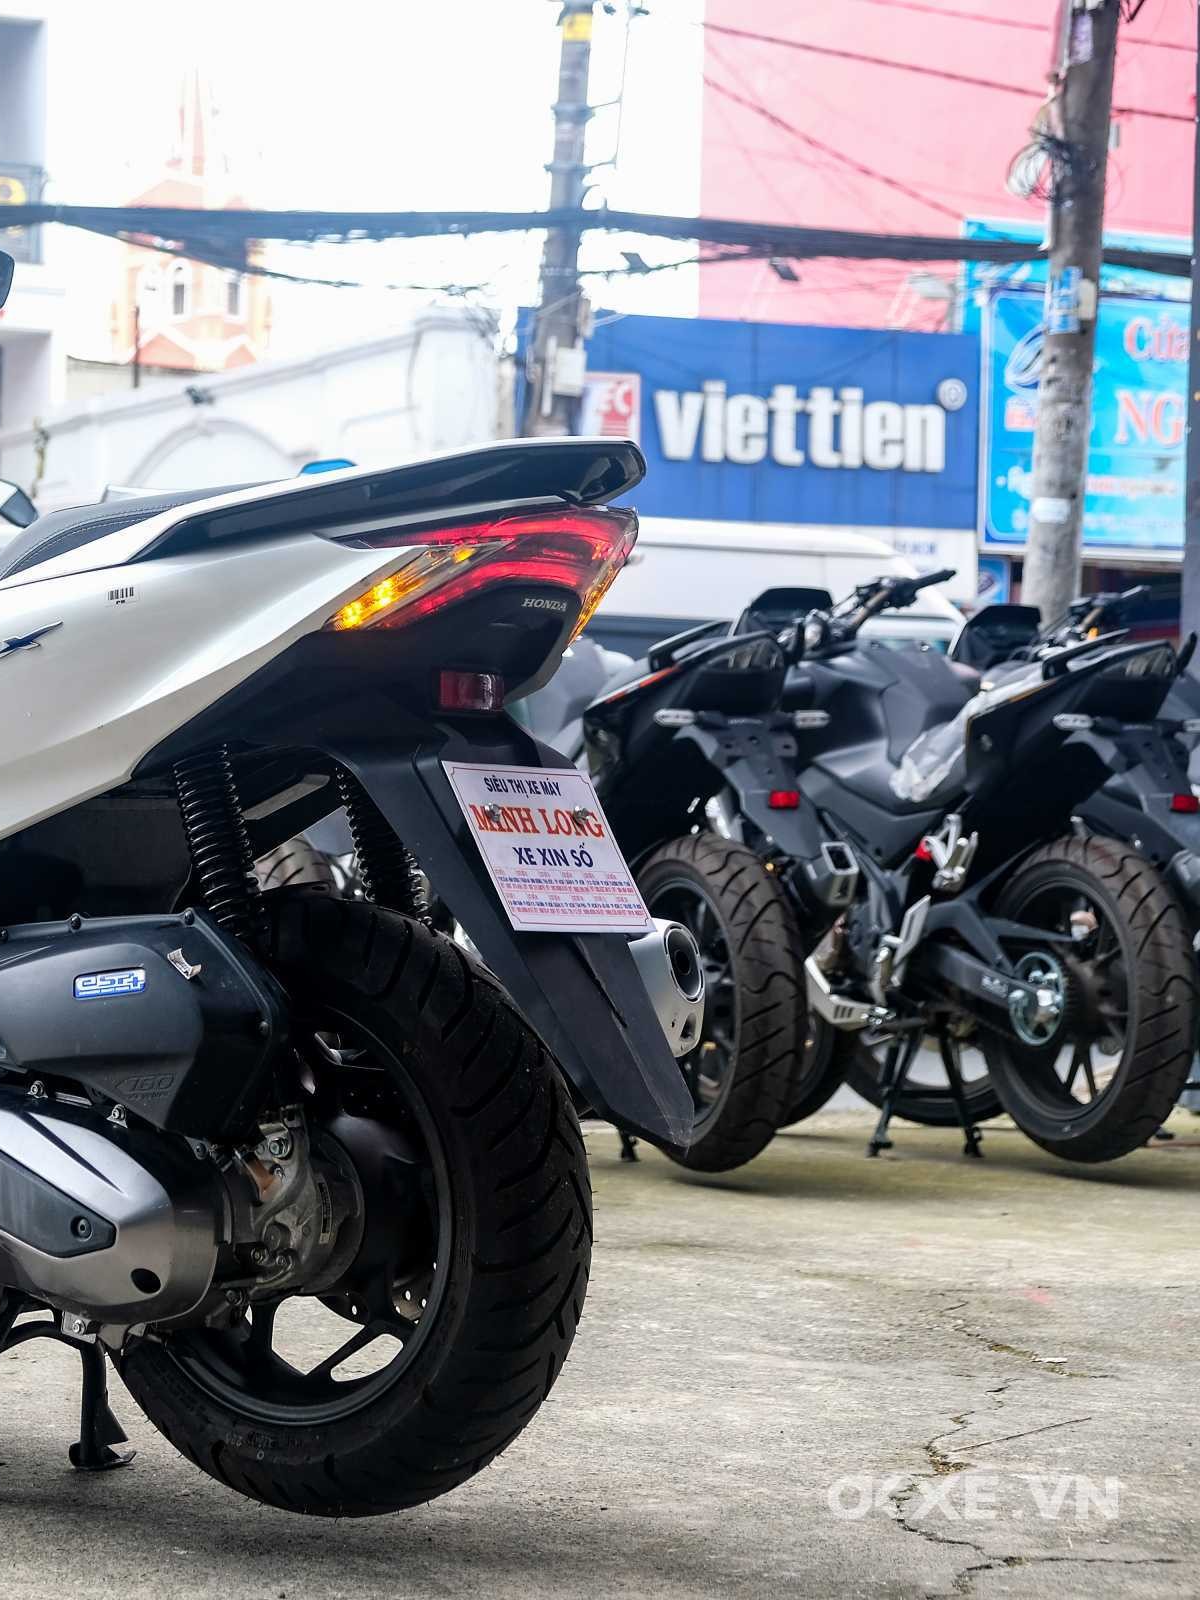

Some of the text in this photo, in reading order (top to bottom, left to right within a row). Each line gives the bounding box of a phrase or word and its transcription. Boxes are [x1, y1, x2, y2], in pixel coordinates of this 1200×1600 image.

[654, 379, 947, 473] viettien
[521, 598, 568, 612] HONDA
[483, 775, 562, 798] SIÊU THỊ XE MÁY
[512, 842, 594, 868] XE XIN SỐ
